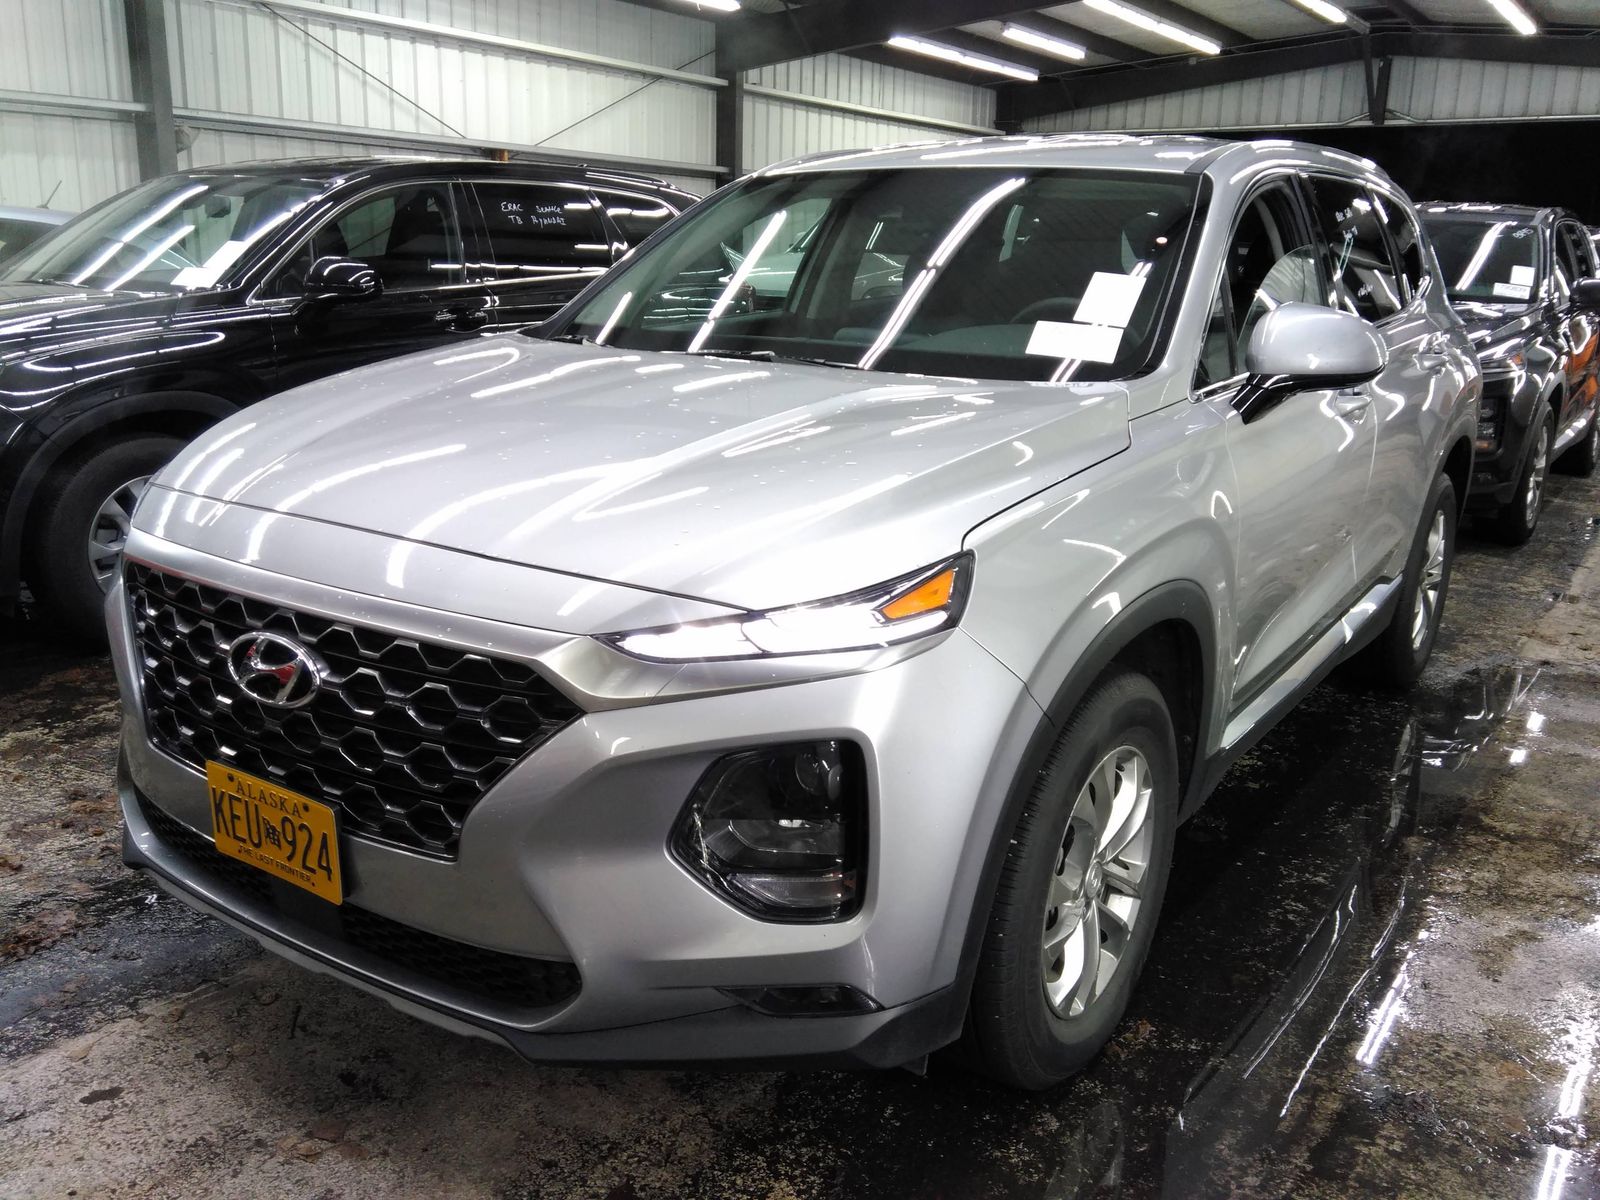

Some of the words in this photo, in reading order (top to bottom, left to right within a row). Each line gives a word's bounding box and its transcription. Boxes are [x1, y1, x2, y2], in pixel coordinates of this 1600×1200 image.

[500, 201, 524, 212] ERAC
[235, 779, 303, 819] ALASKA
[211, 786, 262, 849] KEU
[280, 816, 333, 882] 924
[239, 844, 254, 858] THE
[256, 852, 274, 866] LAST
[275, 860, 311, 881] FRONTIER
